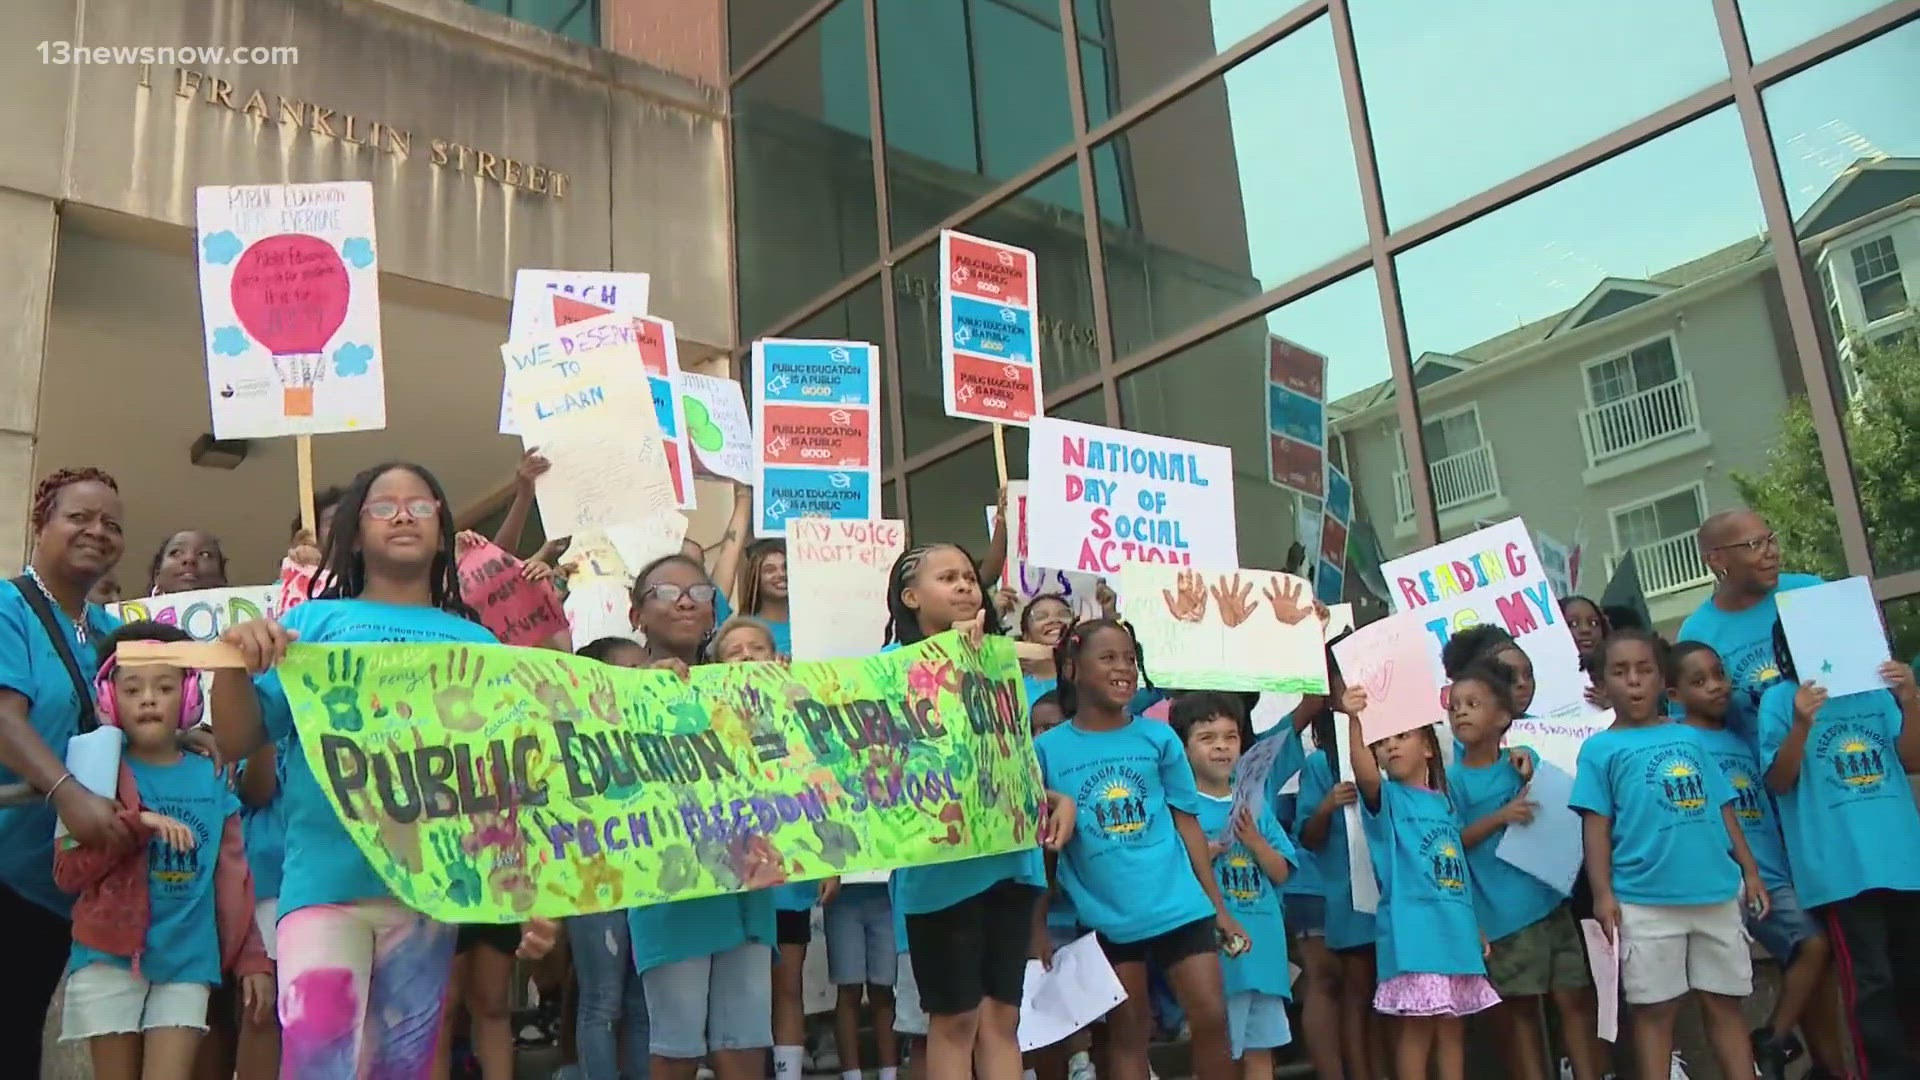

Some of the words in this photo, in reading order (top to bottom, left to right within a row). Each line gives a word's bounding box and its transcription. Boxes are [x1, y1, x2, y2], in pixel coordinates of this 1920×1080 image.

[175, 68, 413, 160] FRANKLIN
[429, 138, 571, 198] STREET
[956, 255, 981, 269] PUBLIC
[982, 261, 1023, 279] EDUCATION
[958, 316, 982, 328] PUBLIC
[983, 320, 1025, 335] EDUCATION
[512, 343, 552, 370] WE
[552, 361, 581, 378] TO
[772, 363, 805, 374] PUBLIC
[806, 364, 861, 375] EDUCATION
[790, 375, 800, 384] IS
[801, 376, 808, 385] A
[809, 376, 842, 386] PUBLIC
[988, 378, 1030, 393] EDUCATION
[535, 386, 604, 420] LEARN
[772, 425, 805, 435] PUBLIC
[806, 426, 862, 437] EDUCATION
[791, 437, 800, 446] IS
[801, 438, 808, 447] A
[809, 437, 842, 448] PUBLIC
[1062, 435, 1209, 486] NATIONAL
[771, 487, 805, 499] PUBLIC
[806, 488, 861, 500] EDUCATION
[790, 499, 799, 509] IS
[800, 500, 808, 510] A
[809, 500, 842, 511] PUBLIC
[1066, 475, 1118, 506] DAY
[1138, 489, 1167, 514] OF
[1090, 508, 1189, 549] SOCIAL
[1397, 541, 1527, 610] READING
[1496, 581, 1555, 638] MY
[320, 733, 549, 825] PUBLIC
[553, 720, 739, 798] EDUCATION
[795, 697, 949, 755] PUBLIC
[1077, 765, 1116, 807] FREEDOM
[1119, 765, 1148, 801] SCHOOL
[679, 783, 830, 847] FREEDOM
[844, 768, 964, 813] SCHOOL
